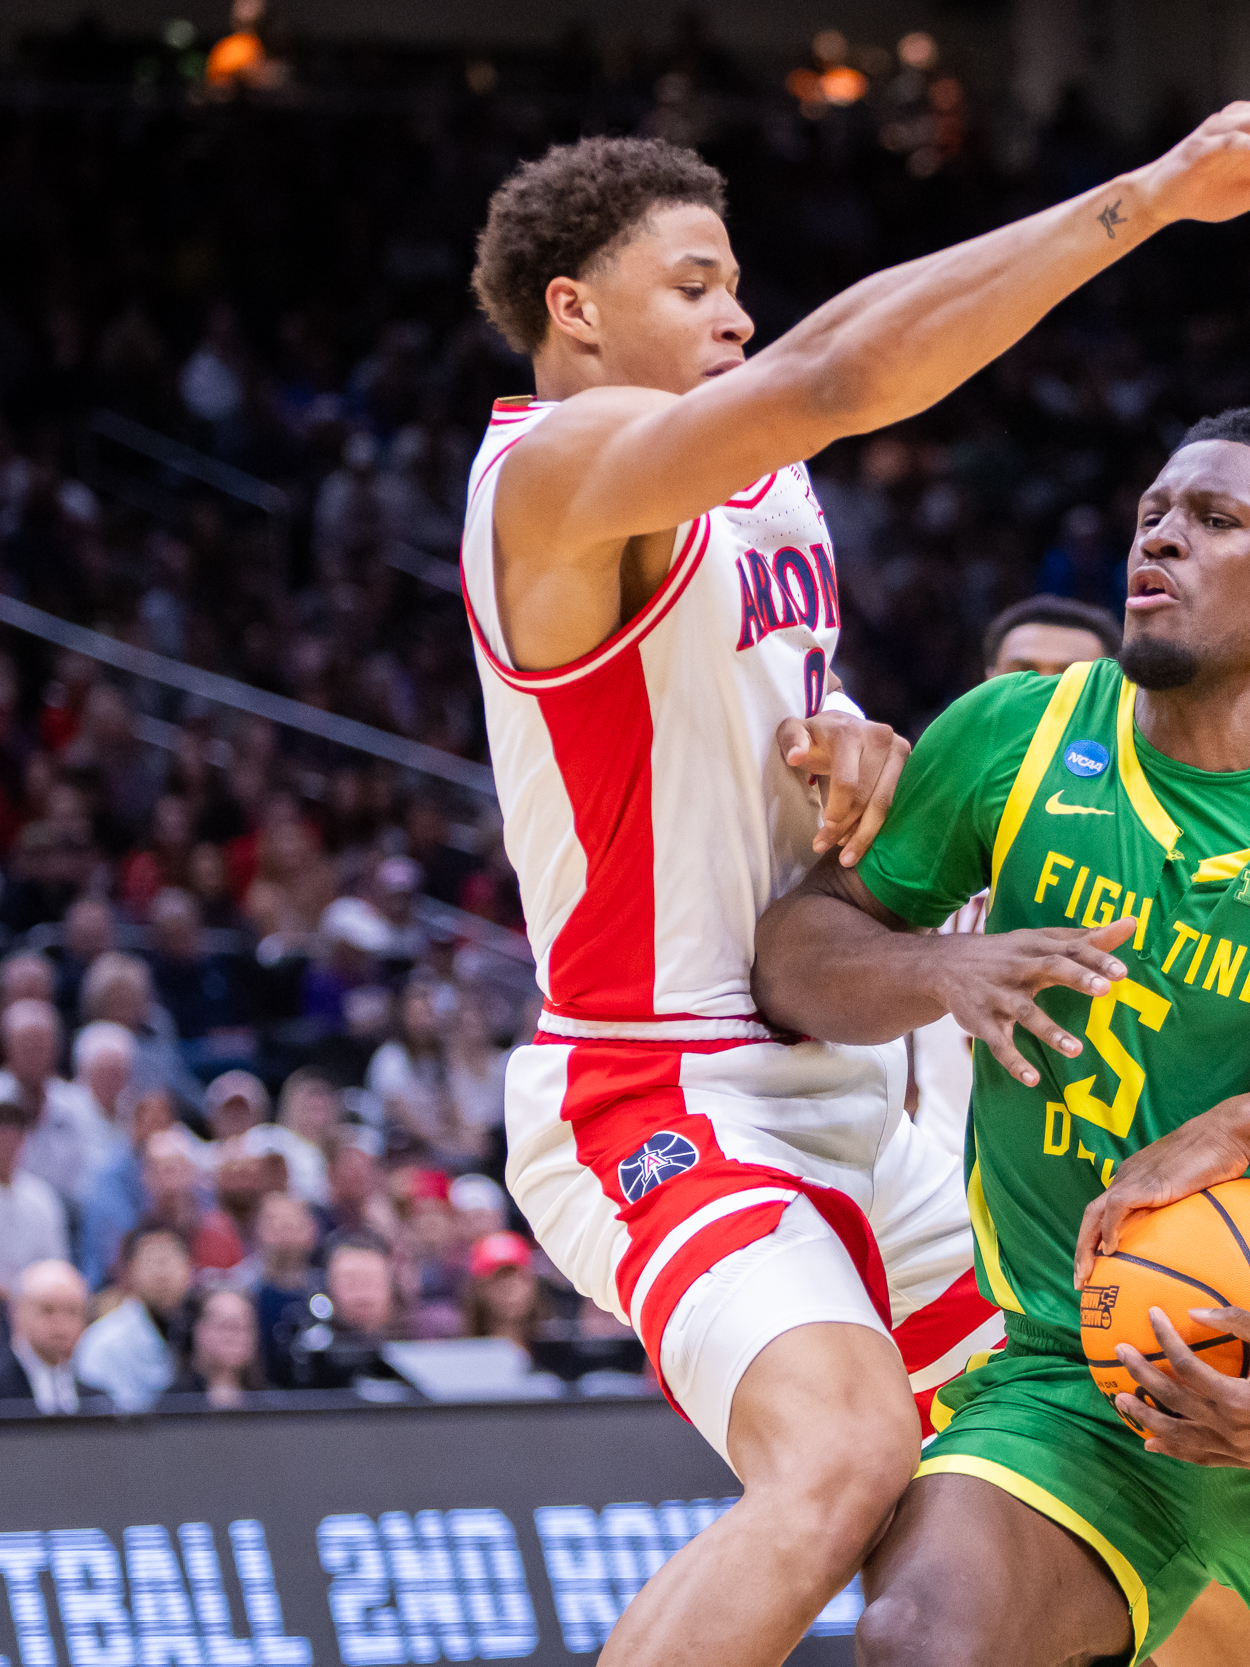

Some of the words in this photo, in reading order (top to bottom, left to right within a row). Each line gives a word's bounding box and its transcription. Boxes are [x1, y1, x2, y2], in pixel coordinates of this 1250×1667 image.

[1067, 752, 1104, 772] NCAA
[1063, 977, 1173, 1139] 5
[0, 1518, 314, 1667] TBALL
[315, 1507, 540, 1667] 2ND
